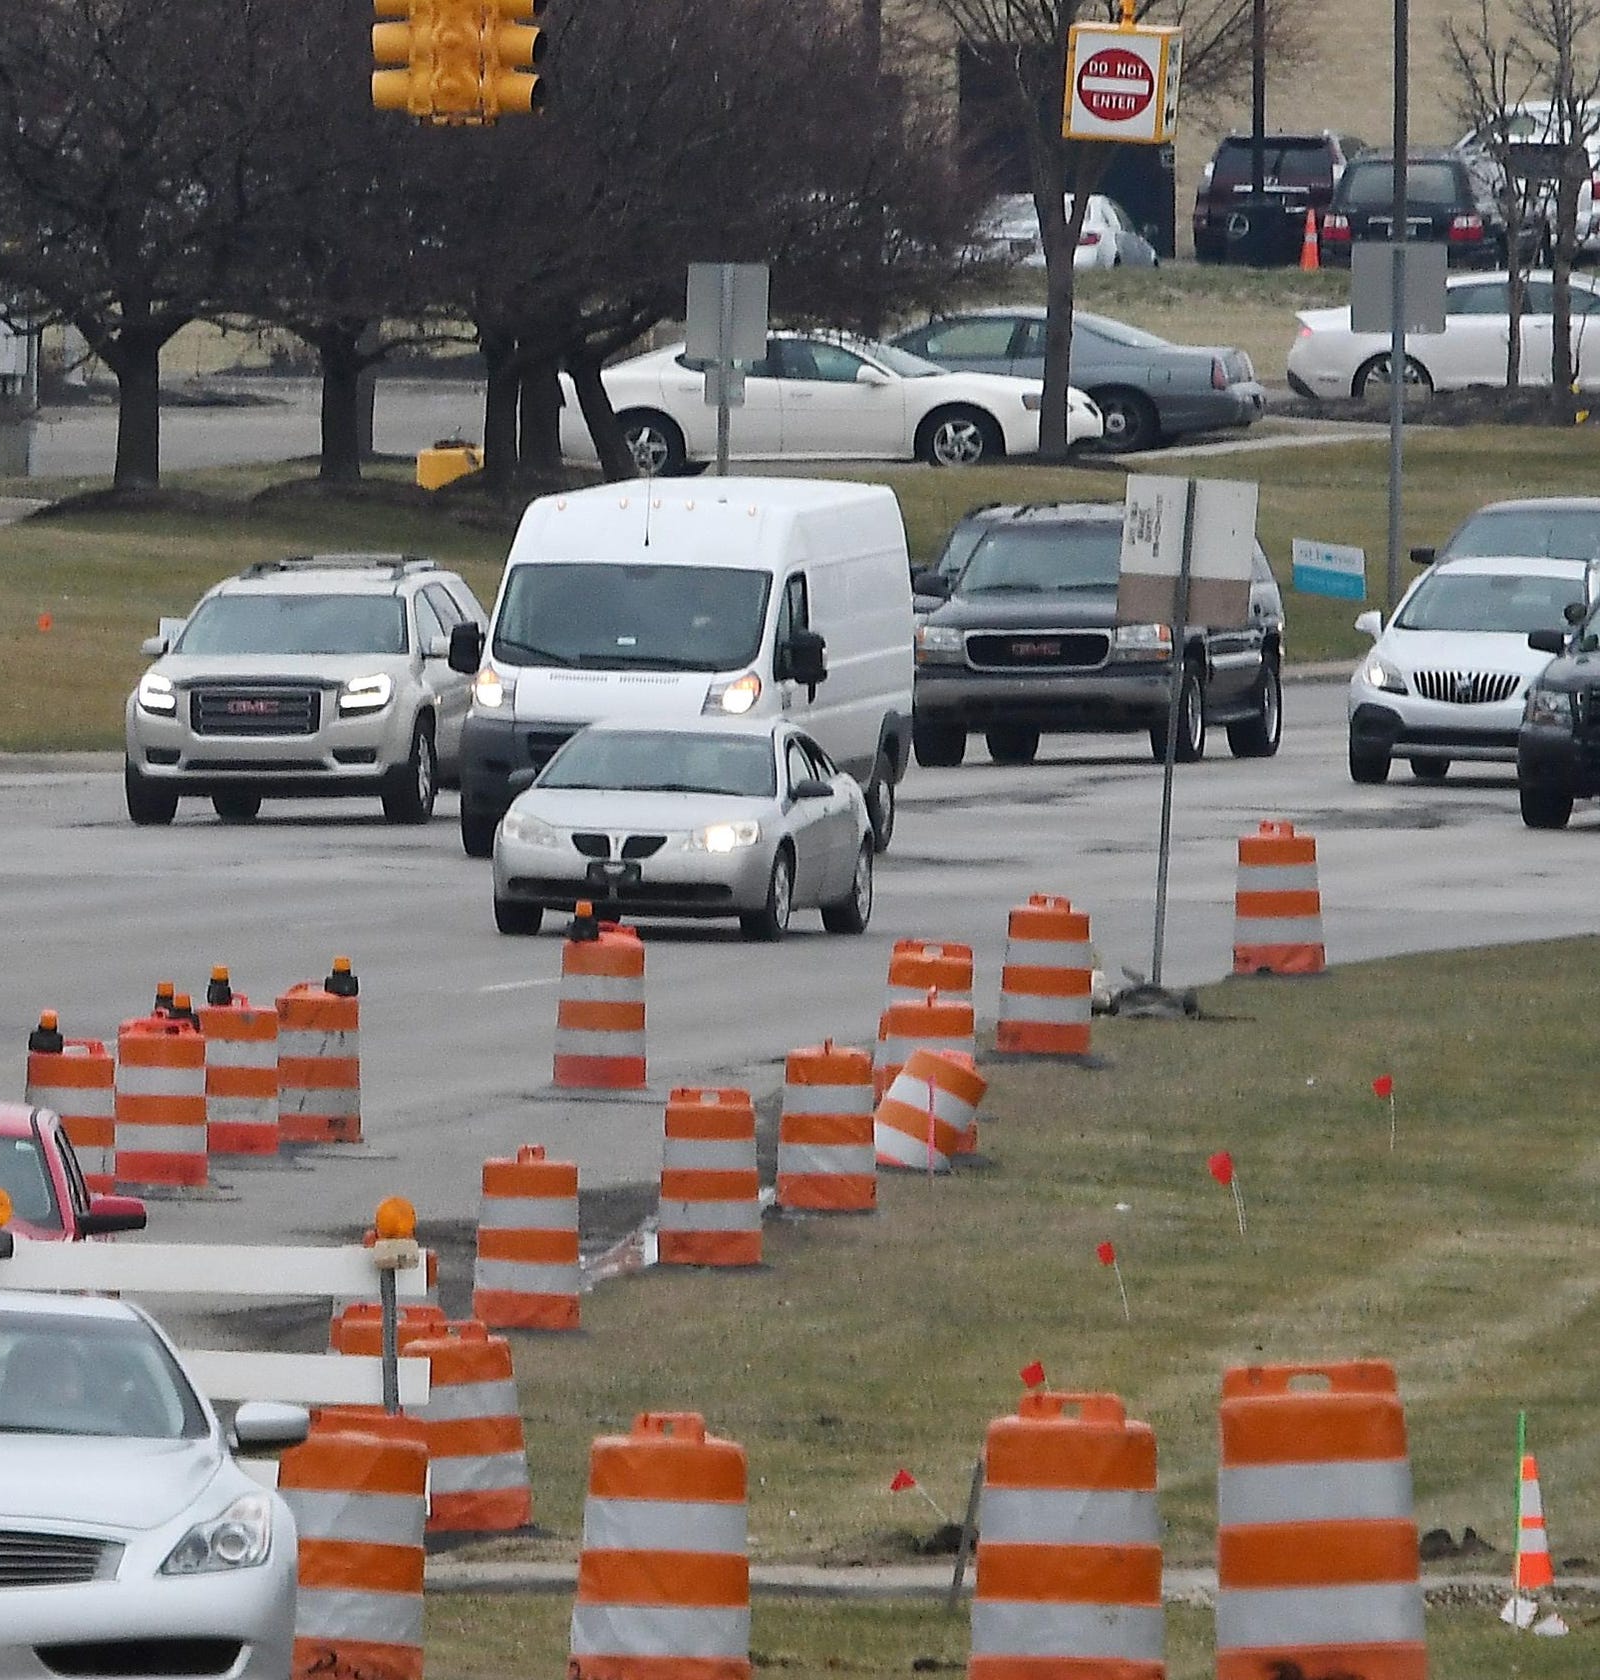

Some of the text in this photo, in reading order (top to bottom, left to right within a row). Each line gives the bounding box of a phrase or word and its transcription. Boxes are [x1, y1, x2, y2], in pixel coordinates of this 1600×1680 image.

[1089, 61, 1144, 77] DO NOT
[1092, 94, 1136, 111] ENTER
[228, 700, 279, 714] GMC
